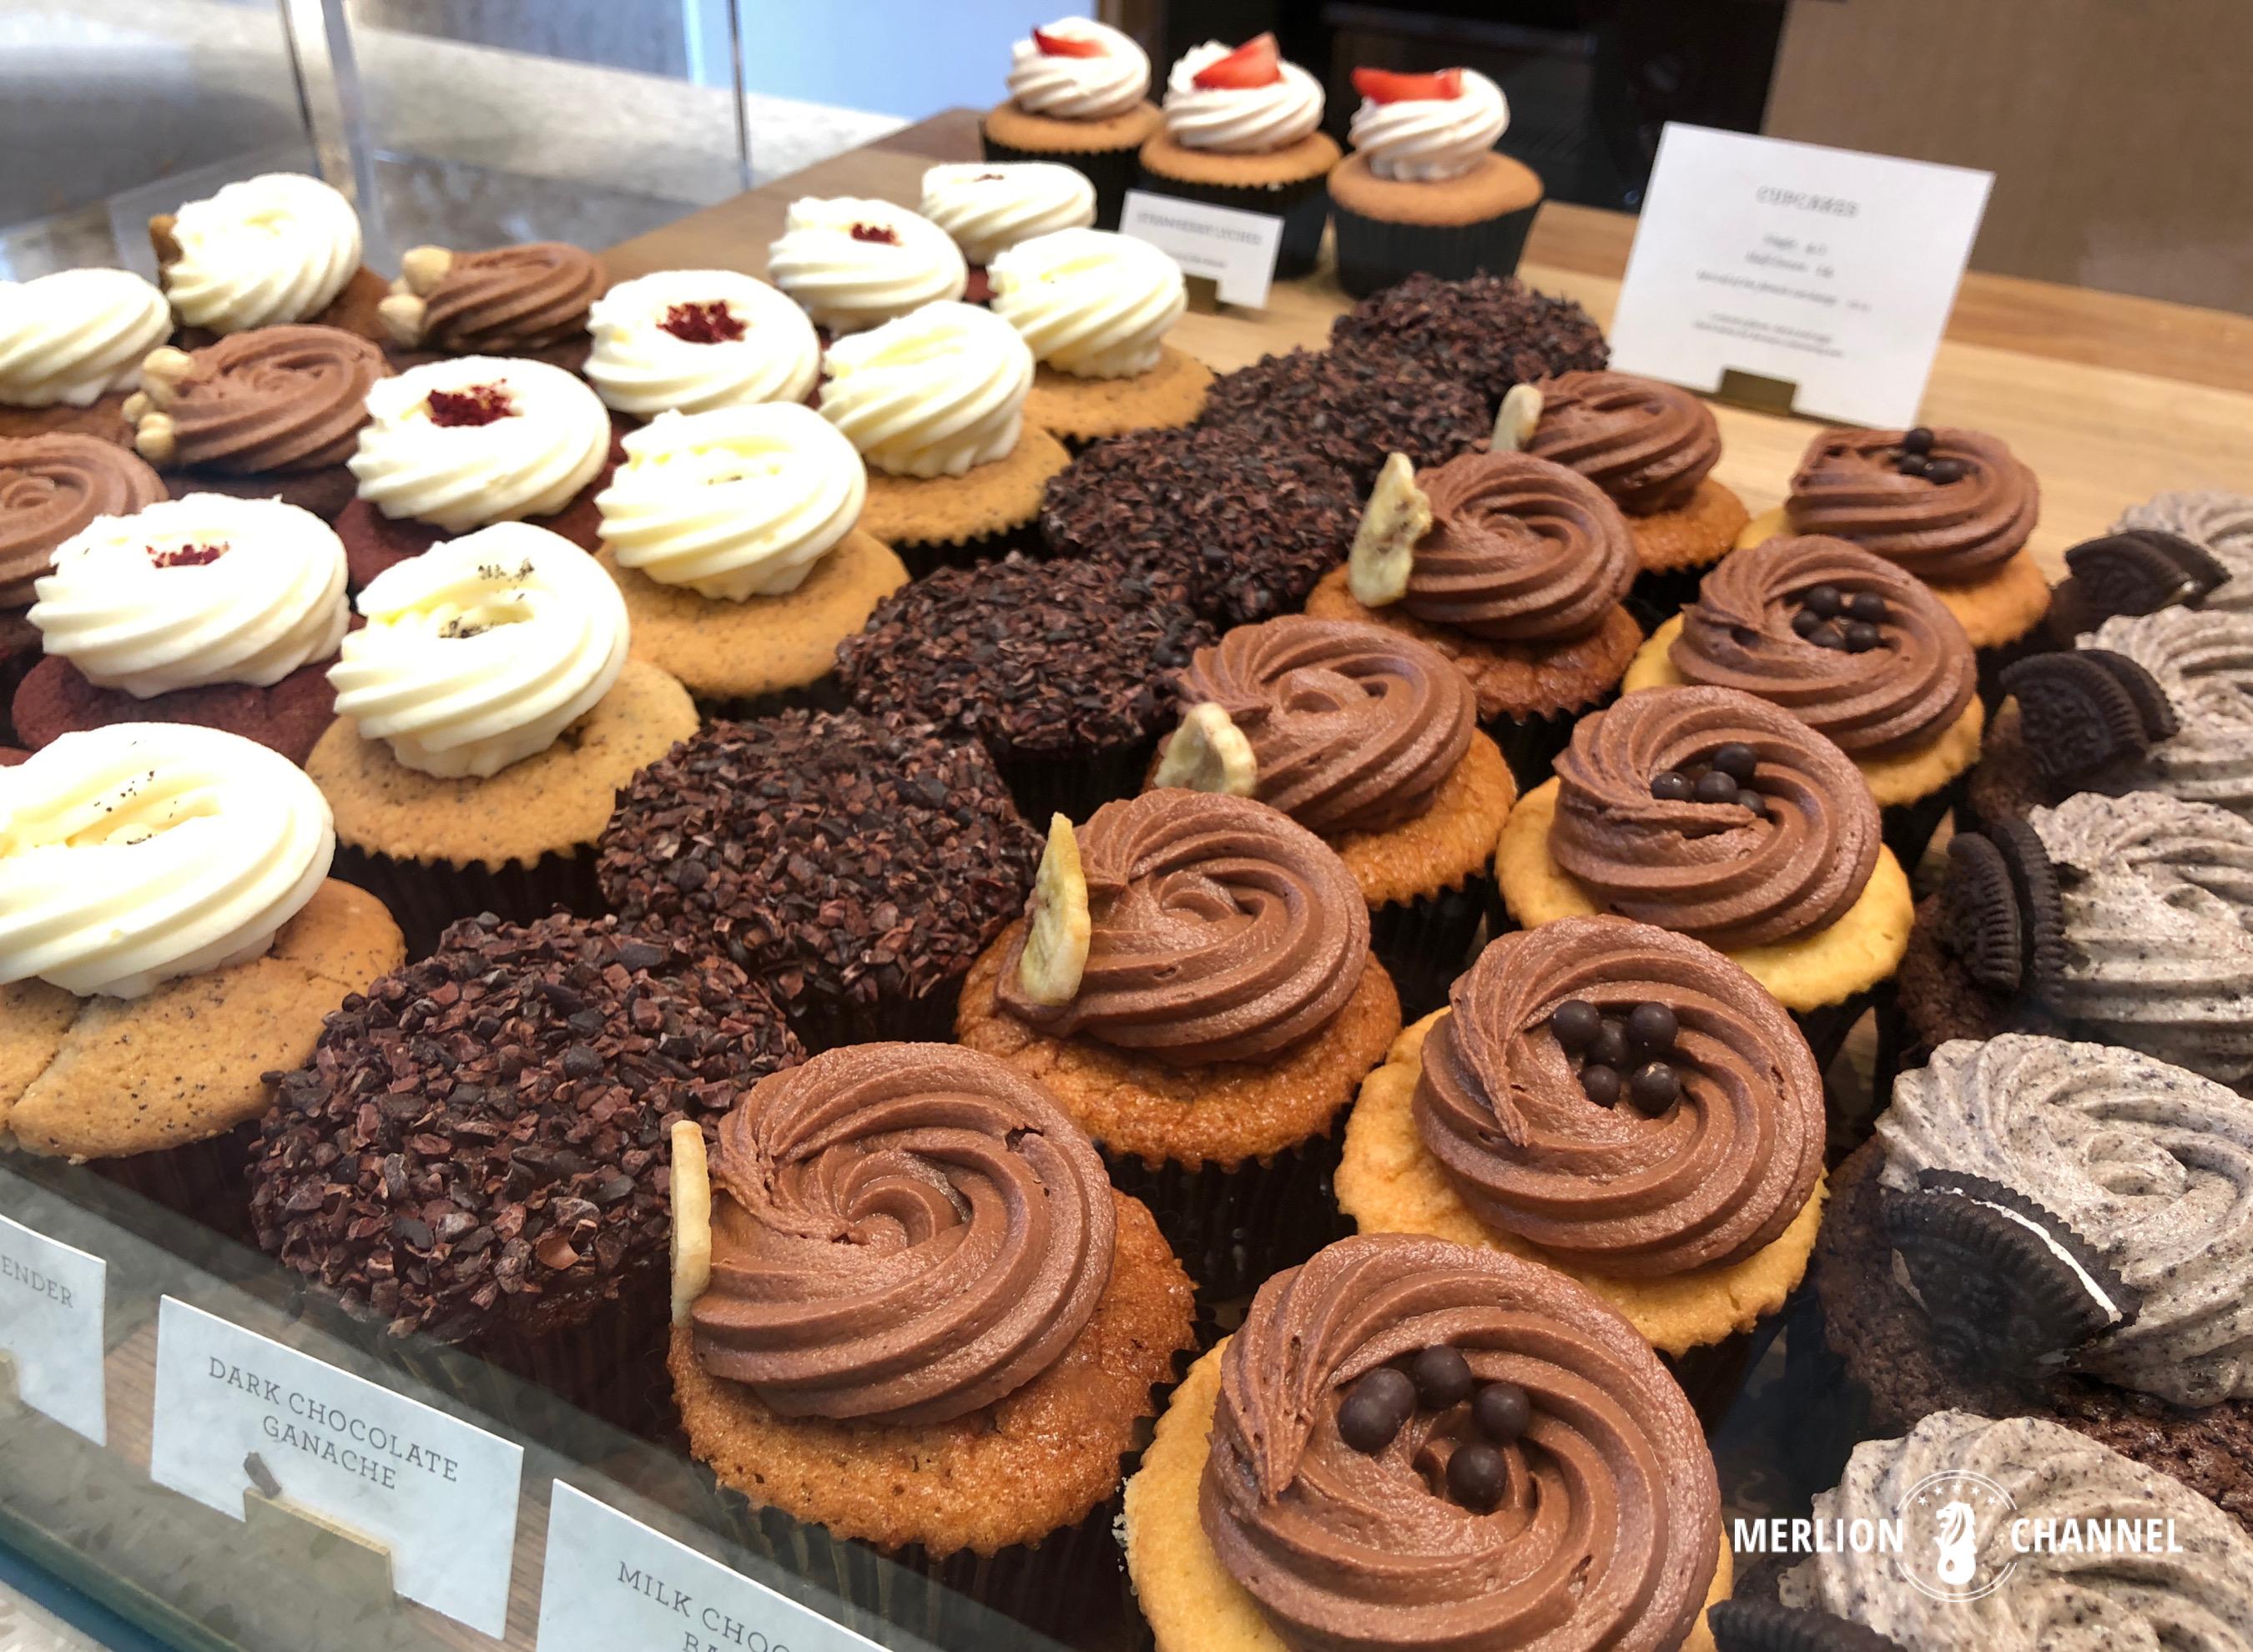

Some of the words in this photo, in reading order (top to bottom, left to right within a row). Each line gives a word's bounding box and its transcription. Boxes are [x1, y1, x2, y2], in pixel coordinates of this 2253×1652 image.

[209, 1357, 280, 1406] DARK
[289, 1393, 458, 1482] CHOCOLATE
[263, 1415, 396, 1489] GANACHE
[617, 1561, 692, 1618] MILK
